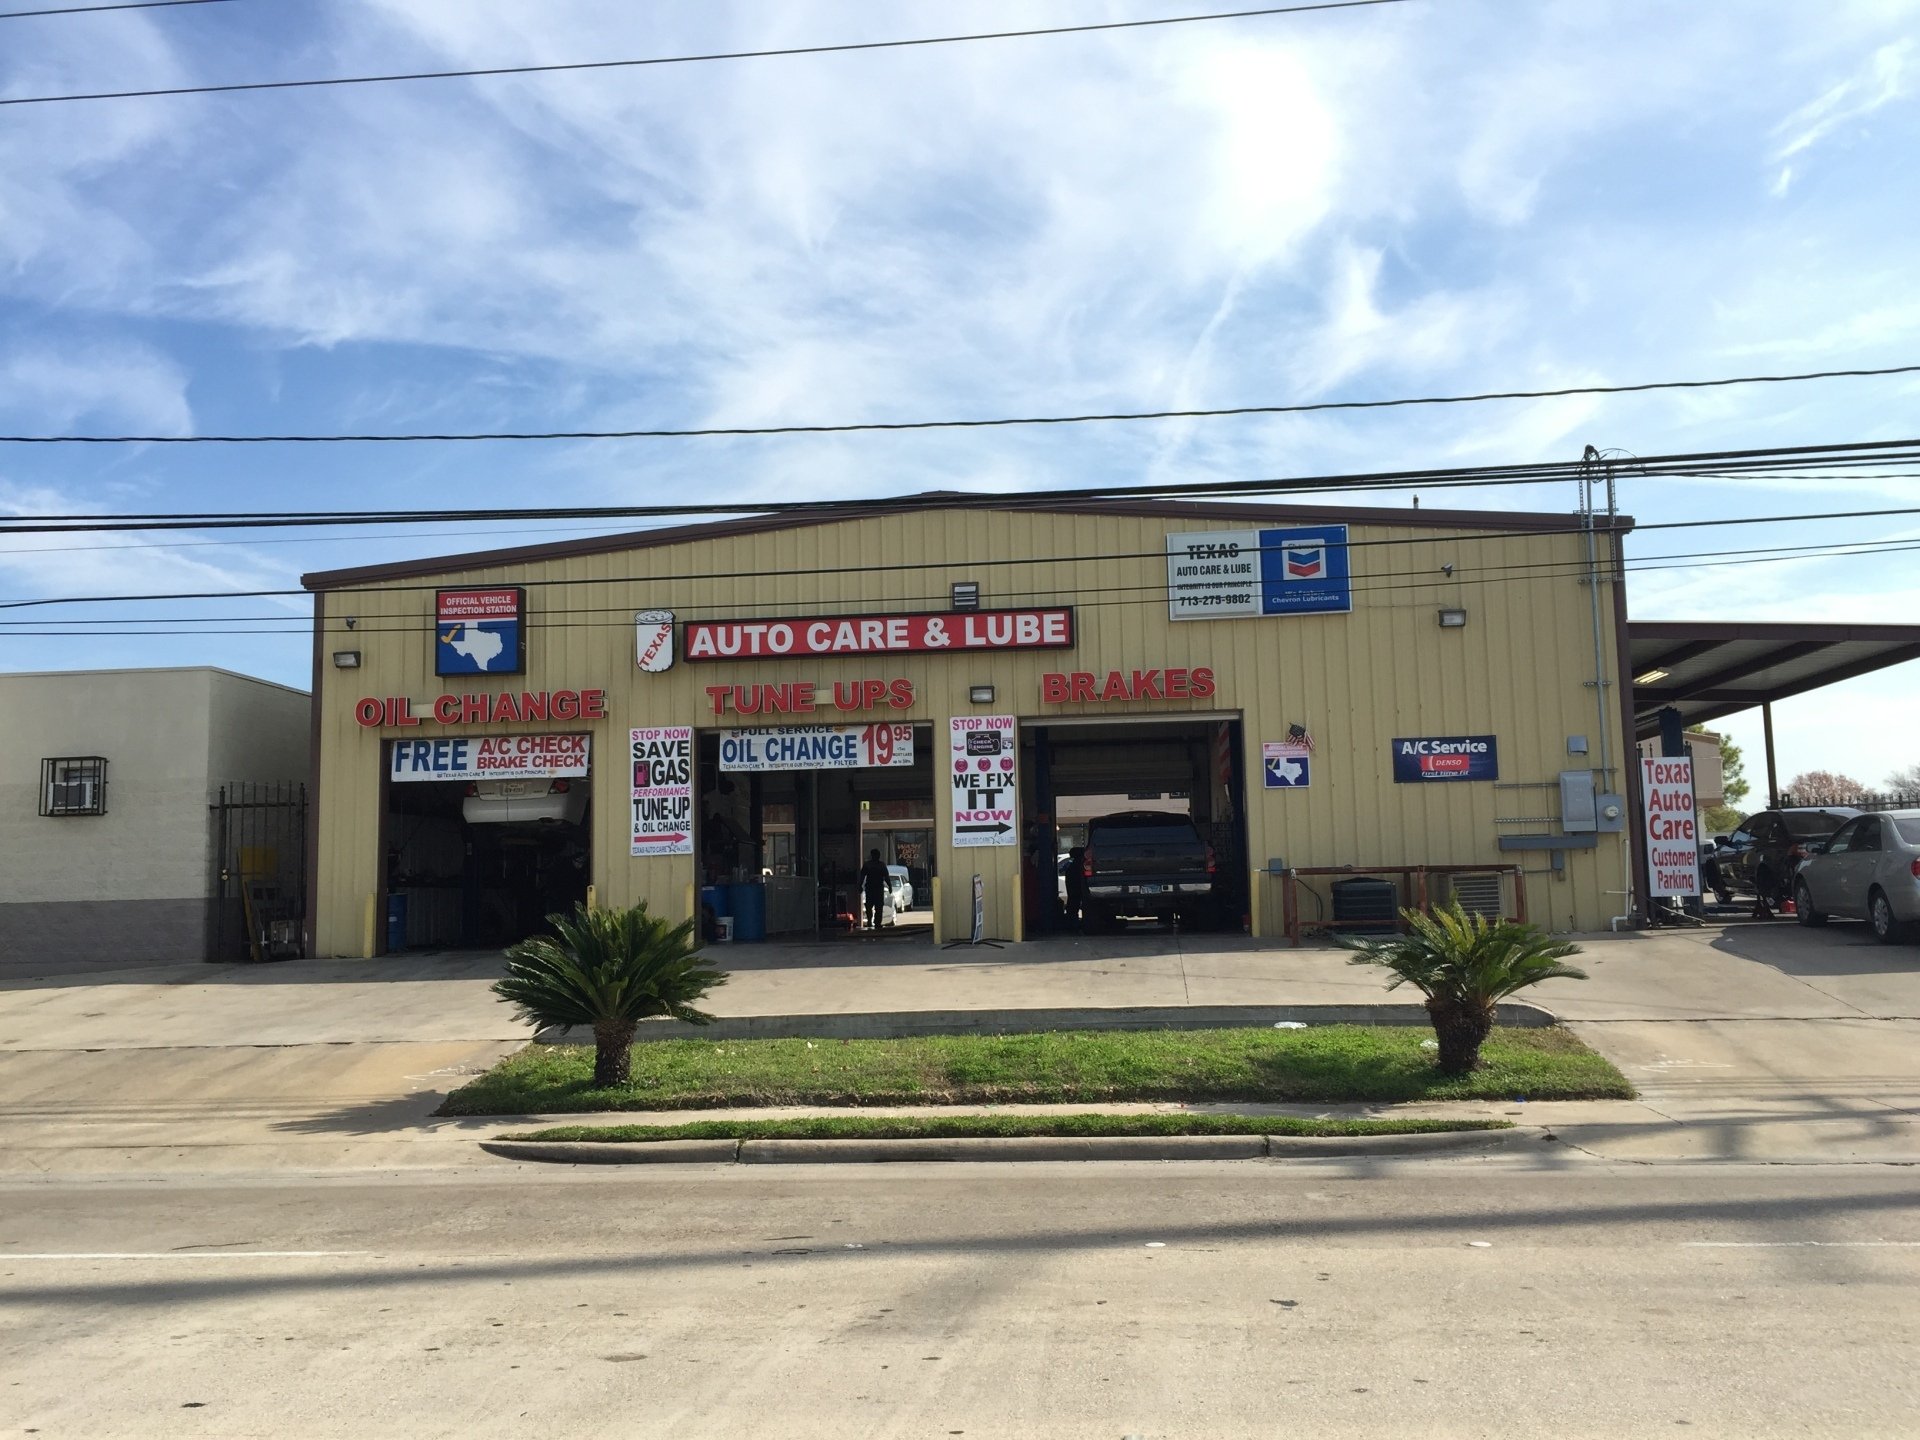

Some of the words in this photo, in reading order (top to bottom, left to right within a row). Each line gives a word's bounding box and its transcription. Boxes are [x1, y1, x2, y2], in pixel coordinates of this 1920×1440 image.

[1187, 543, 1239, 560] TEXAS
[1176, 566, 1198, 577] AUTO
[1200, 564, 1221, 575] CARE
[1222, 564, 1229, 574] &
[1231, 563, 1252, 574] LUBE
[446, 597, 479, 606] OFFICIAL
[480, 595, 511, 604] VEHICLE
[1180, 593, 1251, 606] 713-275-9802
[440, 606, 485, 615] INSPECTION
[486, 605, 517, 613] STATION
[690, 624, 794, 656] AUTO
[806, 618, 910, 651] CARE
[923, 617, 951, 647] &
[965, 613, 1066, 646] LUBE
[639, 623, 672, 667] TEXAS
[1042, 667, 1217, 704] BRAKES
[705, 682, 816, 716] TUNE
[833, 678, 914, 711] UPS
[353, 696, 421, 727] OIL
[432, 689, 605, 725] CHANGE
[740, 728, 773, 737] FULL
[777, 725, 834, 735] SERVICE
[952, 719, 982, 730] STOP
[986, 717, 1013, 729] NOW
[632, 730, 661, 741] STOP
[664, 728, 690, 739] NOW
[478, 737, 512, 756] A/C
[516, 735, 586, 755] CHECK
[632, 740, 690, 759] SAVE
[722, 739, 758, 763] OIL
[765, 734, 858, 762] CHANGE
[1401, 741, 1428, 755] A/C
[1431, 739, 1488, 754] Service
[395, 739, 469, 773] FREE
[476, 756, 528, 770] BRAKE
[532, 754, 585, 768] CHECK
[651, 758, 690, 786] GAS
[953, 774, 980, 788] WE
[986, 772, 1015, 787] FIX
[1645, 759, 1690, 784] Texas
[633, 787, 690, 797] PERFORMANCE
[968, 788, 1003, 810] IT
[1648, 788, 1692, 812] Auto
[633, 796, 690, 821] TUNE-UP
[955, 810, 1012, 822] NOW
[634, 822, 640, 833] &
[642, 822, 656, 833] OIL
[657, 821, 691, 832] CHANGE
[1649, 814, 1694, 841] Care
[1652, 848, 1696, 867] Customer
[1657, 869, 1694, 892] Parking
